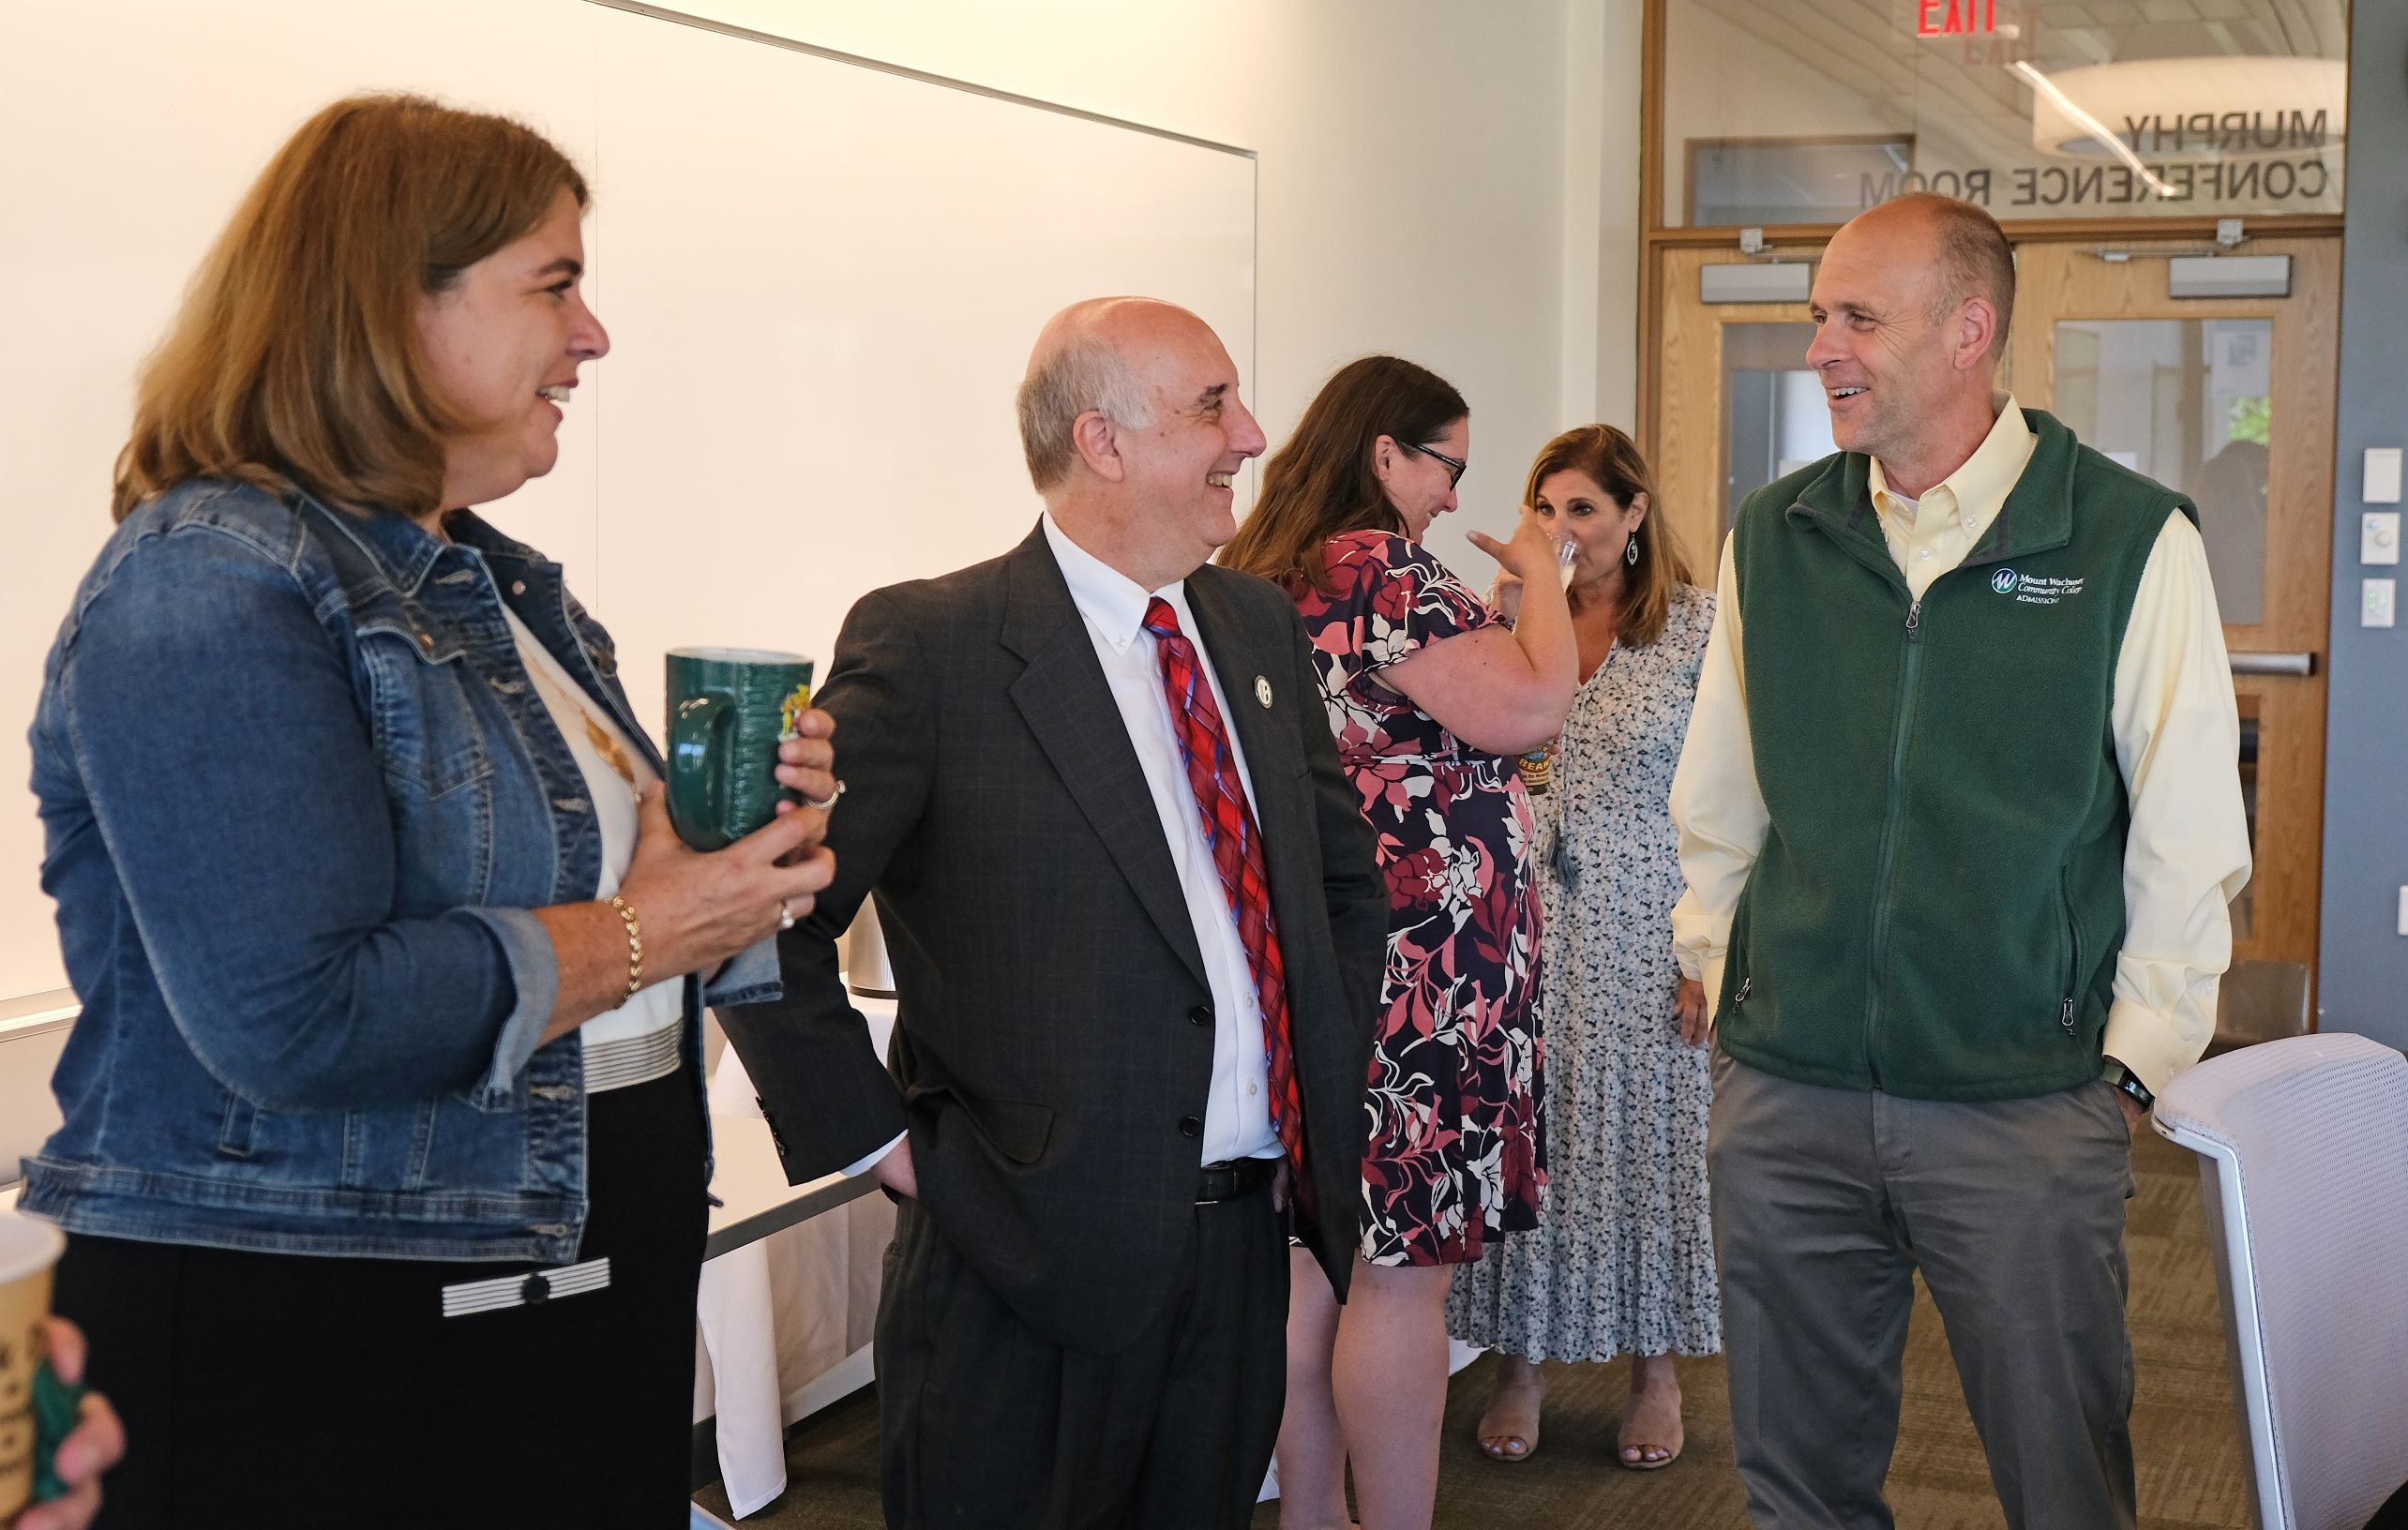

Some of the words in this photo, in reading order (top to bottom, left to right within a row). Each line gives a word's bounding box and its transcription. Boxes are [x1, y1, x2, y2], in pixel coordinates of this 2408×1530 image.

[1918, 0, 1995, 38] EXIT
[2019, 574, 2047, 586] Mount
[2018, 582, 2060, 596] Community
[2016, 594, 2060, 605] ADMISSION
